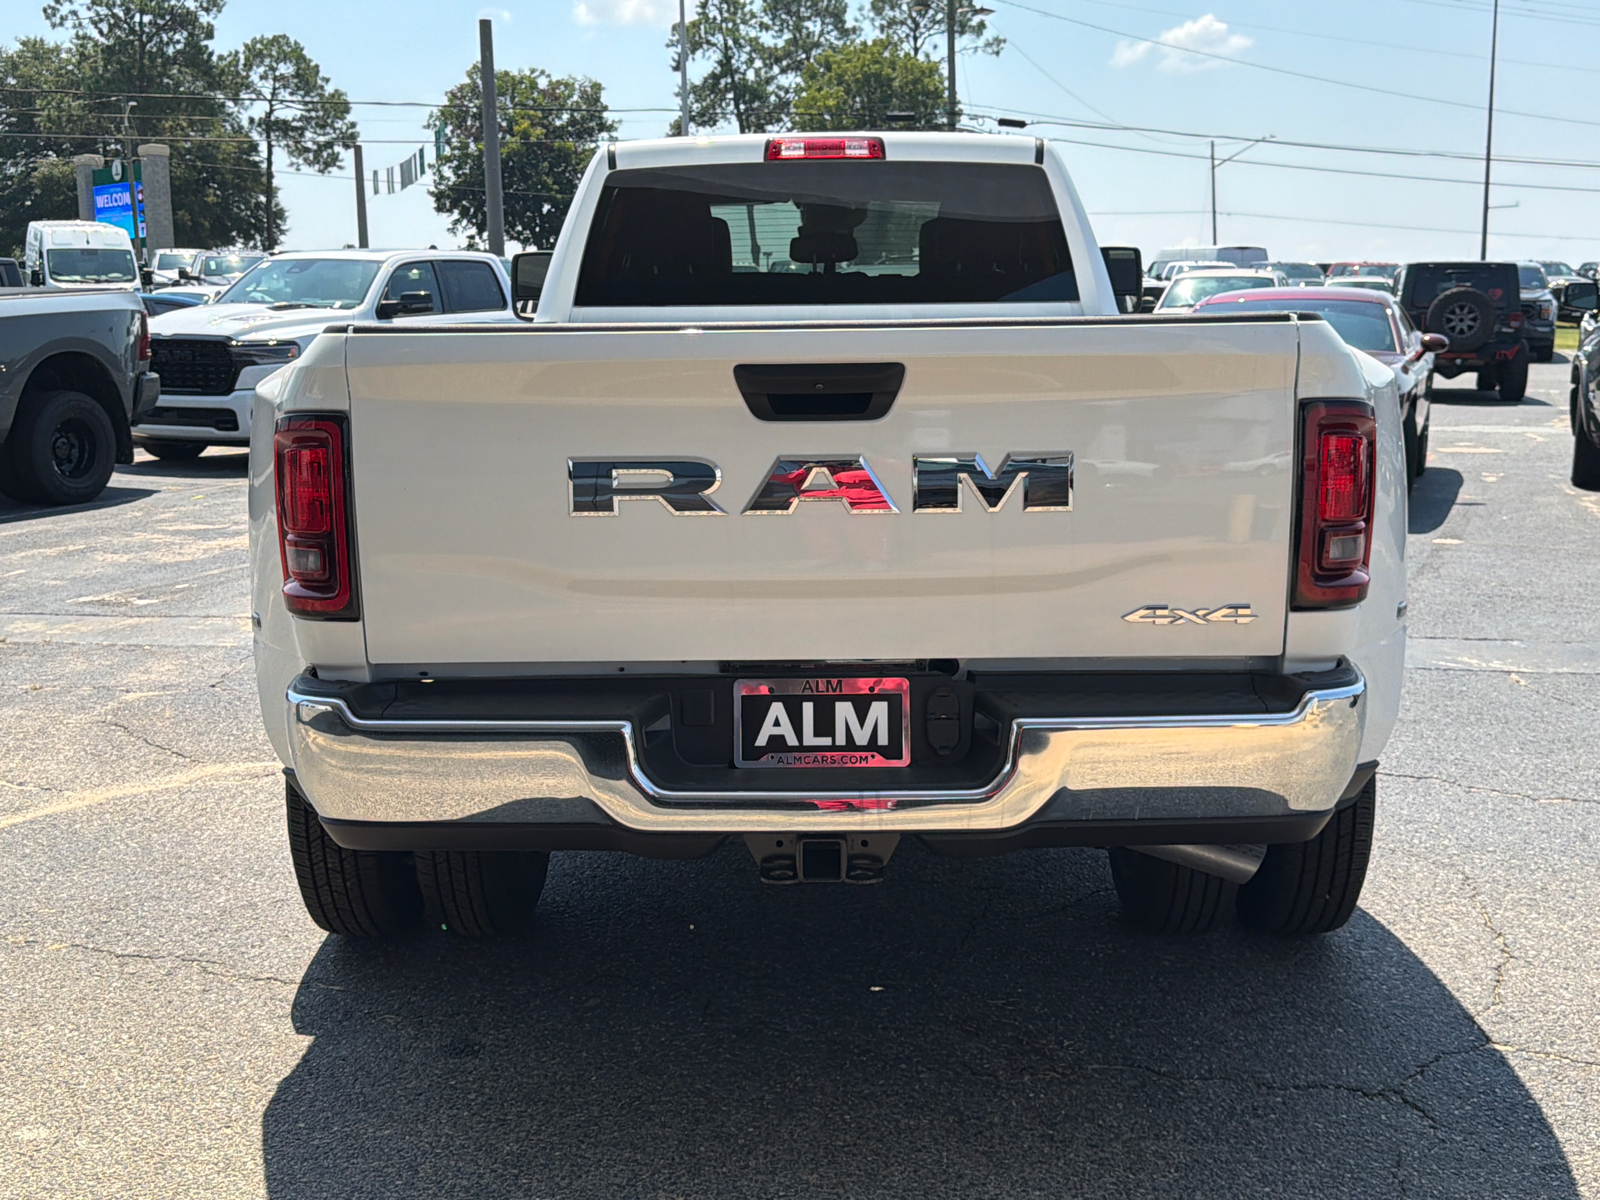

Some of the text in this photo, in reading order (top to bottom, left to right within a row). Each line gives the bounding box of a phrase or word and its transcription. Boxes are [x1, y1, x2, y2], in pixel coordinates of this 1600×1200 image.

[96, 192, 131, 208] WELCOM
[567, 451, 1074, 517] RAM
[801, 679, 843, 693] ALM
[754, 701, 889, 746] ALM
[776, 755, 869, 765] ALMCARS.COM
